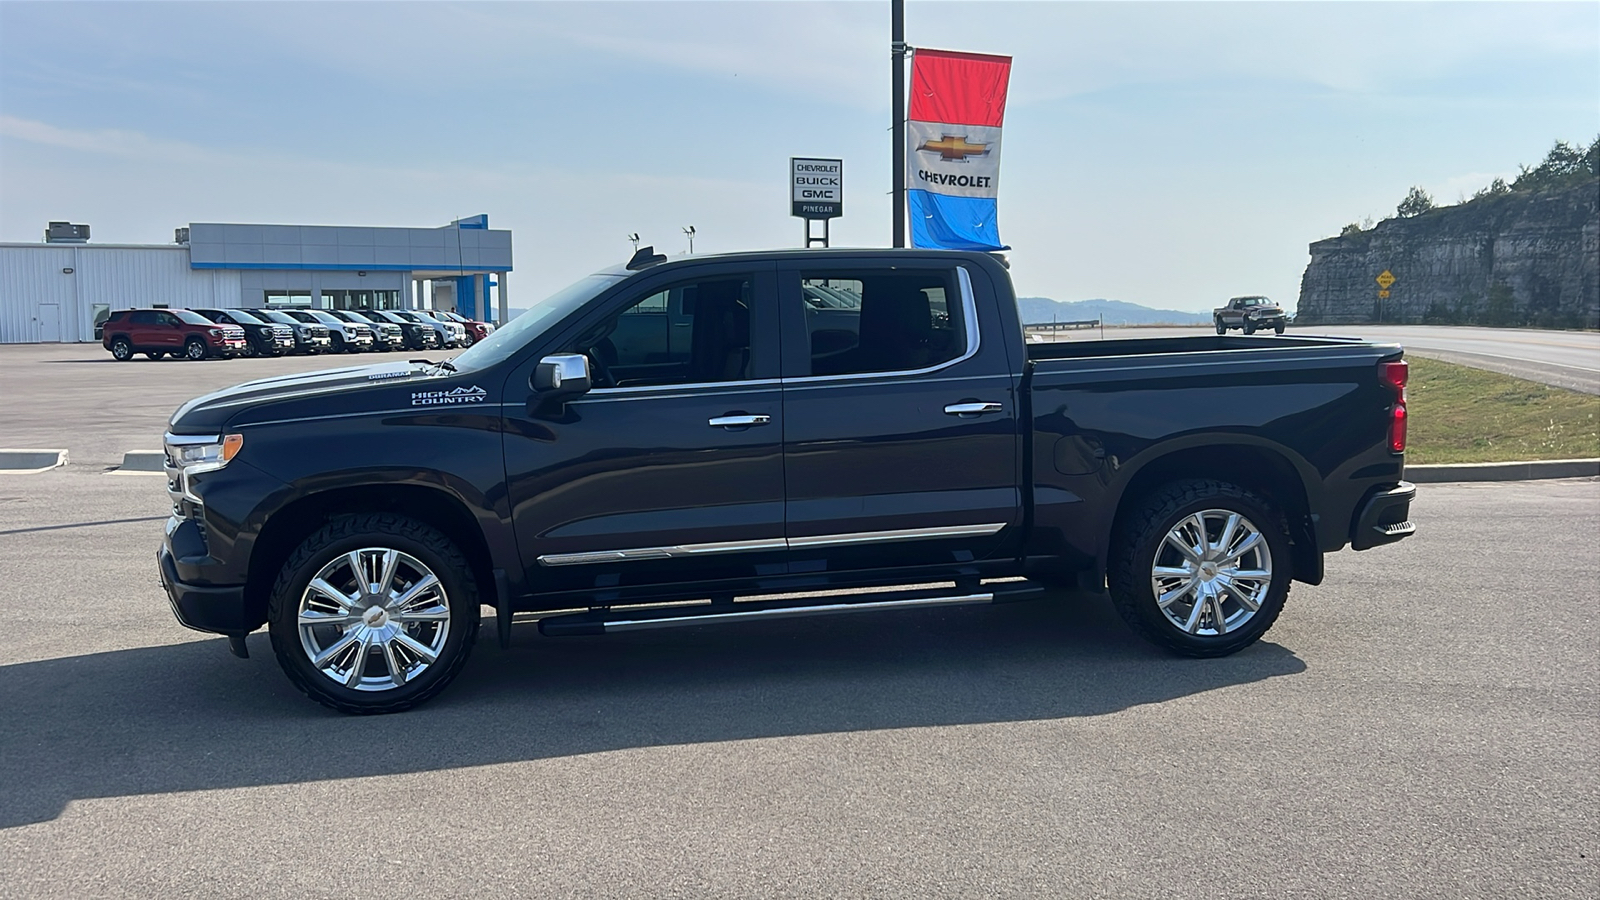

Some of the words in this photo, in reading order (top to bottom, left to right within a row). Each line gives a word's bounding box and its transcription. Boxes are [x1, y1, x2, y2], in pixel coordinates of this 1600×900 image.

[797, 164, 838, 173] CHEVROLET
[796, 177, 839, 186] BUICK
[802, 190, 833, 199] GMC
[802, 205, 833, 213] PINEGAR
[411, 391, 449, 399] HIGH
[411, 395, 486, 405] COUNTRY
